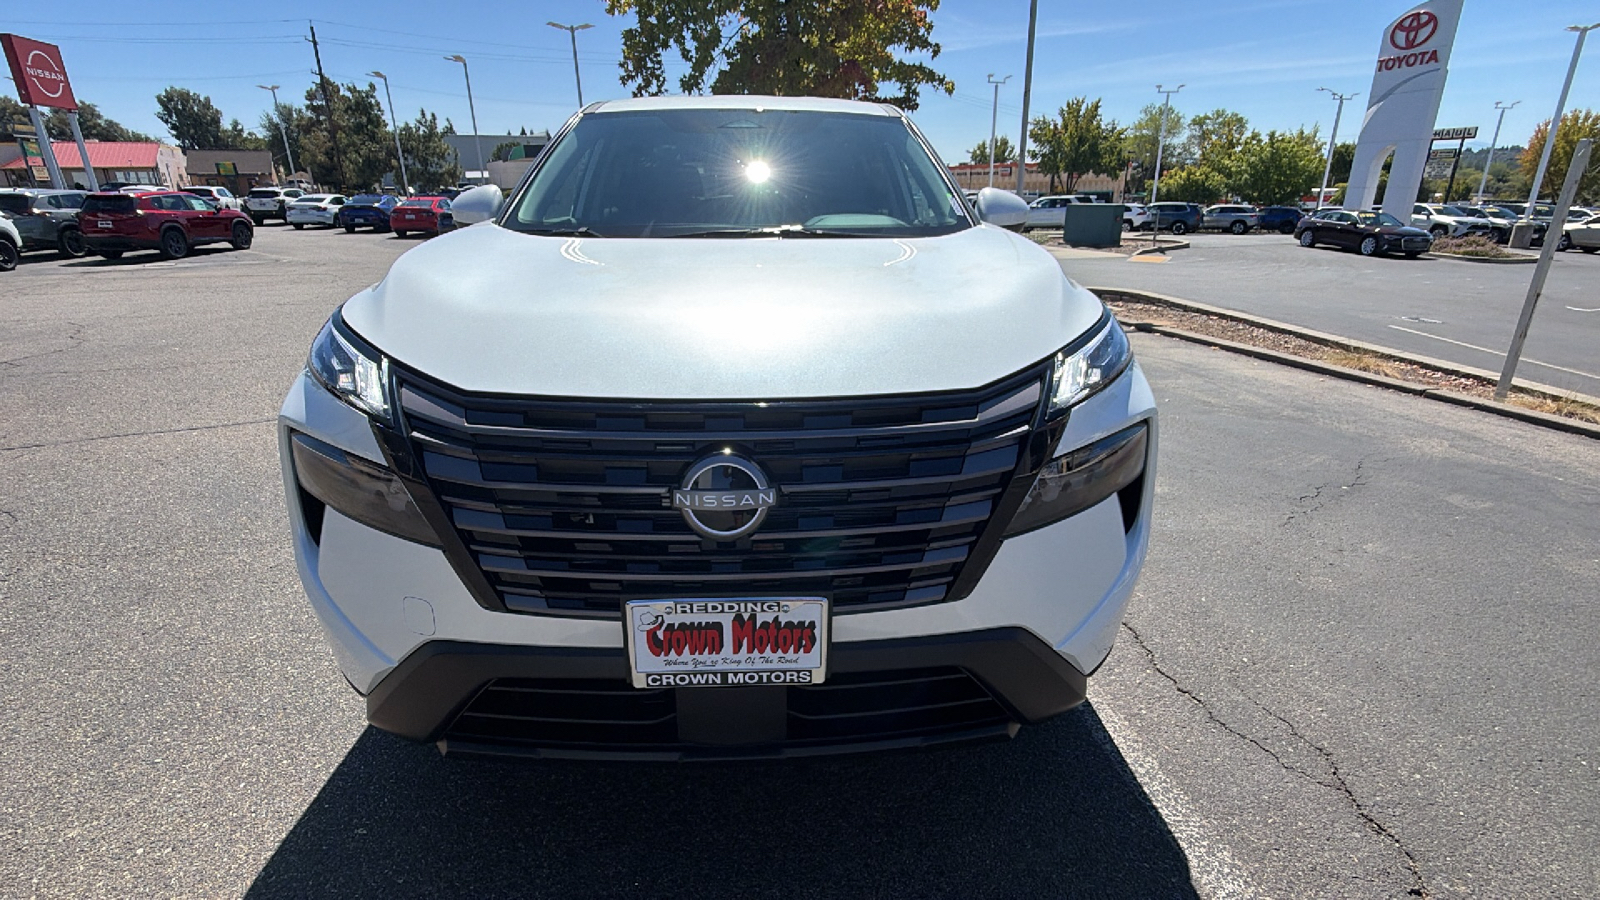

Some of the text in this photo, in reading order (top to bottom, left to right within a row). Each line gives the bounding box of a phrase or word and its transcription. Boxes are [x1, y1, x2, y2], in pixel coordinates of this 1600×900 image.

[1377, 49, 1439, 72] TOYOTA
[26, 66, 64, 81] NISSAN
[675, 491, 774, 507] NISSAN
[676, 602, 779, 614] REDDING
[646, 613, 817, 657] Crown Motors
[663, 658, 689, 667] Where
[721, 657, 742, 667] King
[744, 656, 756, 667] Of
[759, 656, 774, 665] The
[776, 656, 800, 665] Road
[647, 671, 811, 686] CROWN MOTORS
